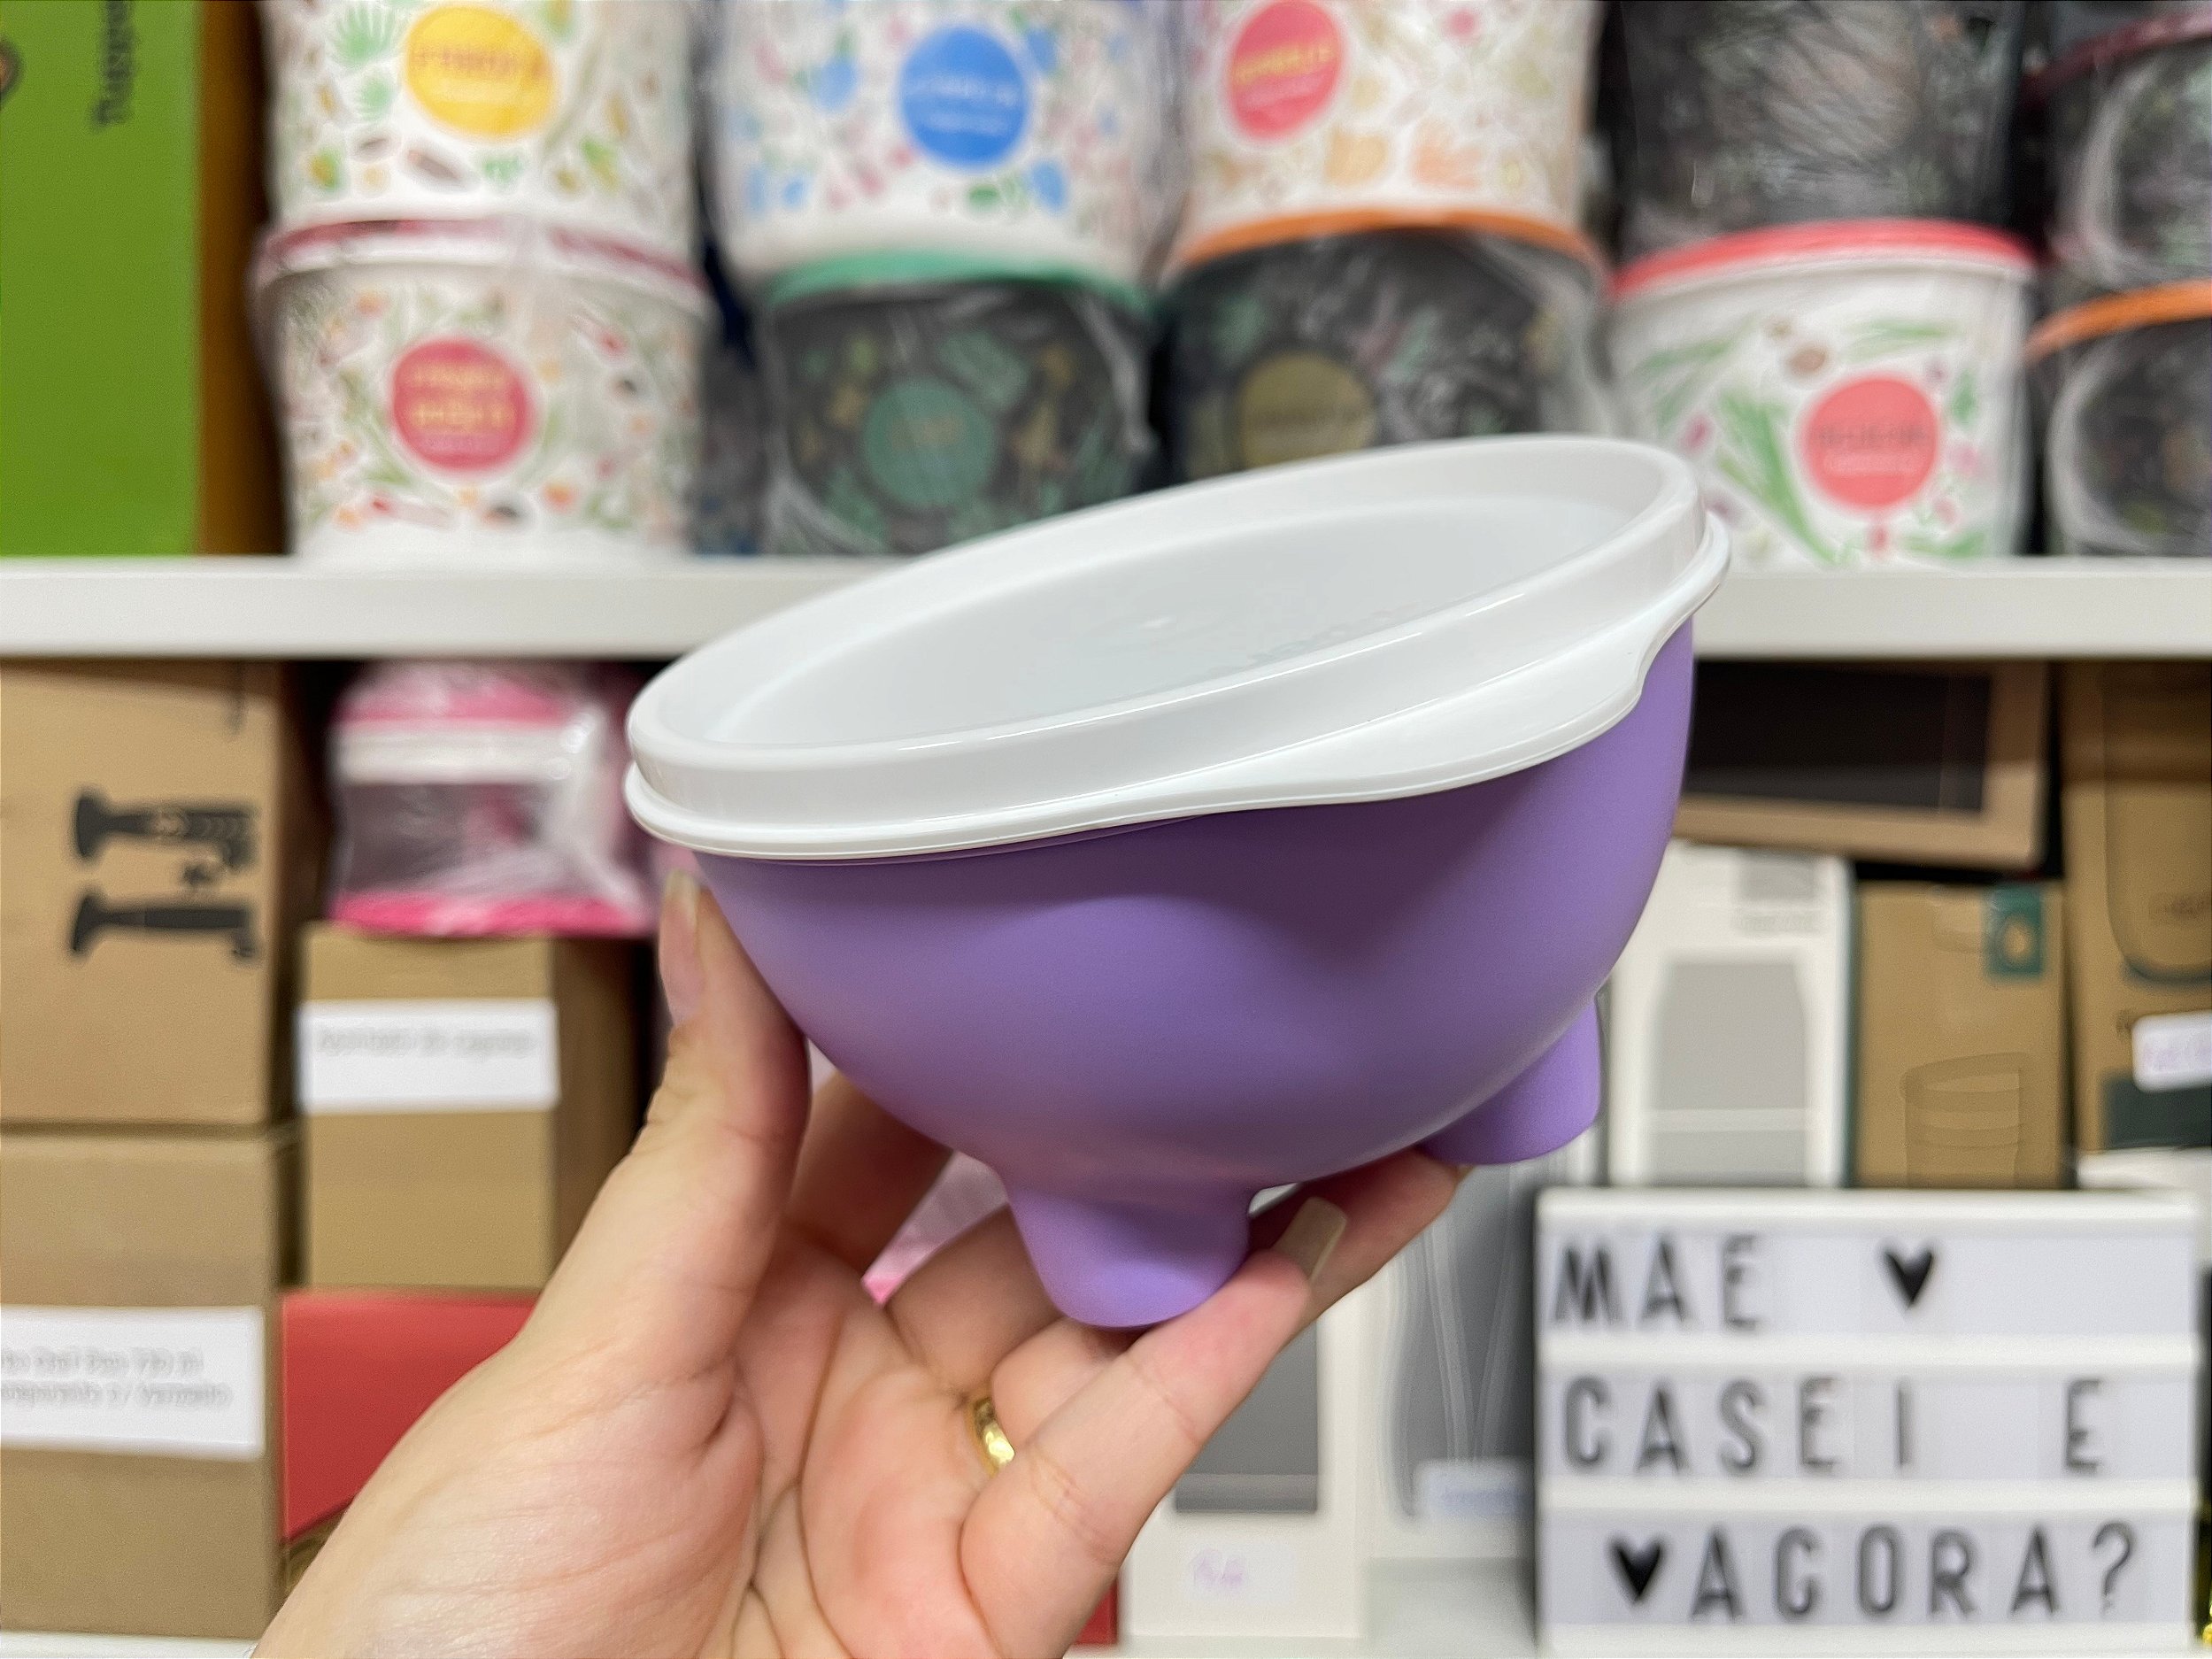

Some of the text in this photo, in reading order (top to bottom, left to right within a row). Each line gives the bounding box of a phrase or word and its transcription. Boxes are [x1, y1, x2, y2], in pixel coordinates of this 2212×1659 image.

[1553, 1235, 1762, 1328] MAE
[1562, 1375, 2108, 1476] CASEI E
[1689, 1520, 2136, 1624] AGORA?
